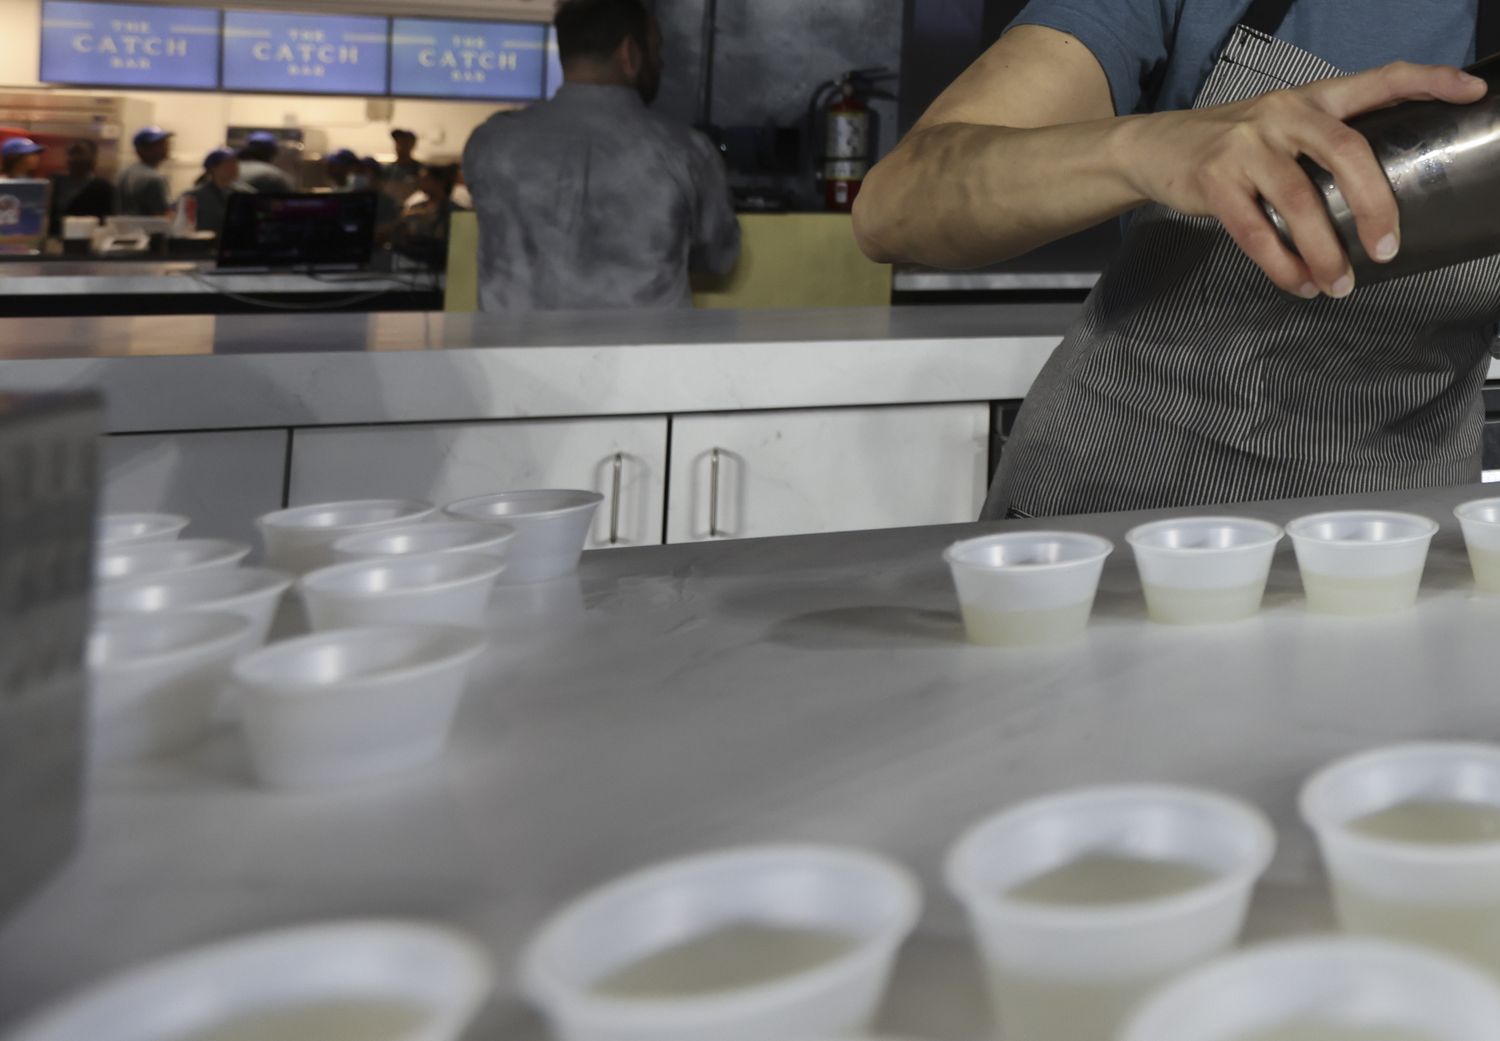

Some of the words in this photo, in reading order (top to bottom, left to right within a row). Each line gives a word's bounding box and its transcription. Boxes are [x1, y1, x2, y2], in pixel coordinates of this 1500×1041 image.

[111, 19, 151, 33] THE
[71, 33, 187, 57] CATCH
[252, 41, 359, 64] CATCH
[110, 57, 151, 69] BAR
[418, 48, 517, 71] CATCH
